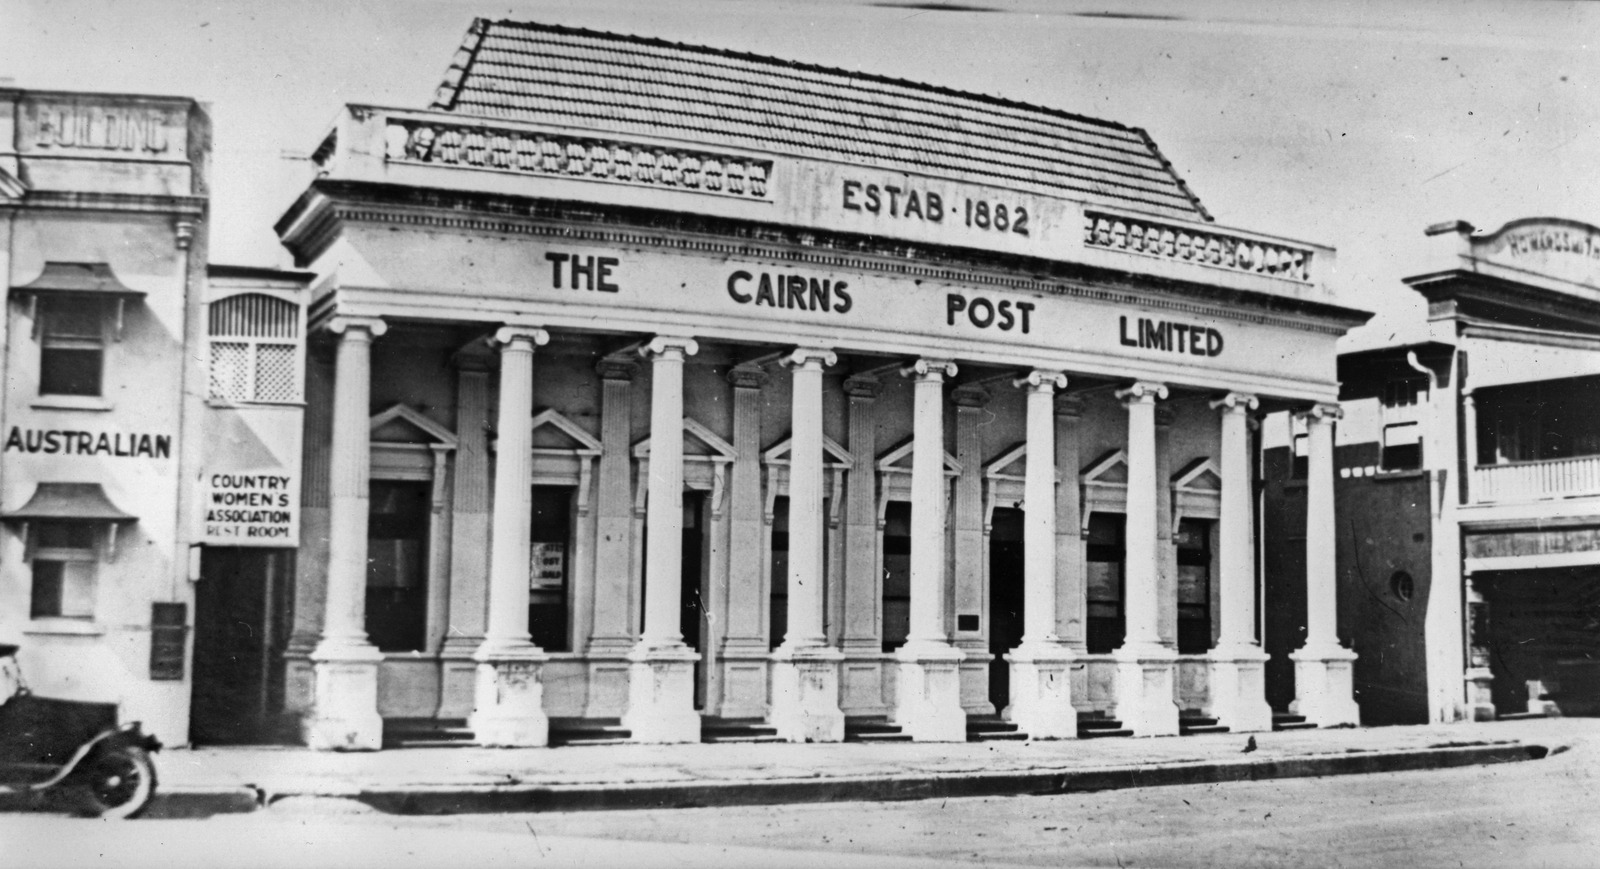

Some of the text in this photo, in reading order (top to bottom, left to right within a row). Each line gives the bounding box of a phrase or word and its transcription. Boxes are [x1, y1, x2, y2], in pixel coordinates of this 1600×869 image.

[964, 198, 1030, 234] 1882
[546, 252, 1225, 357] THE CAIRNS POST LIMITED
[4, 425, 171, 460] AUSTRALIAN
[211, 473, 290, 490] COUNTRY
[207, 509, 291, 523] ASSOCIATION
